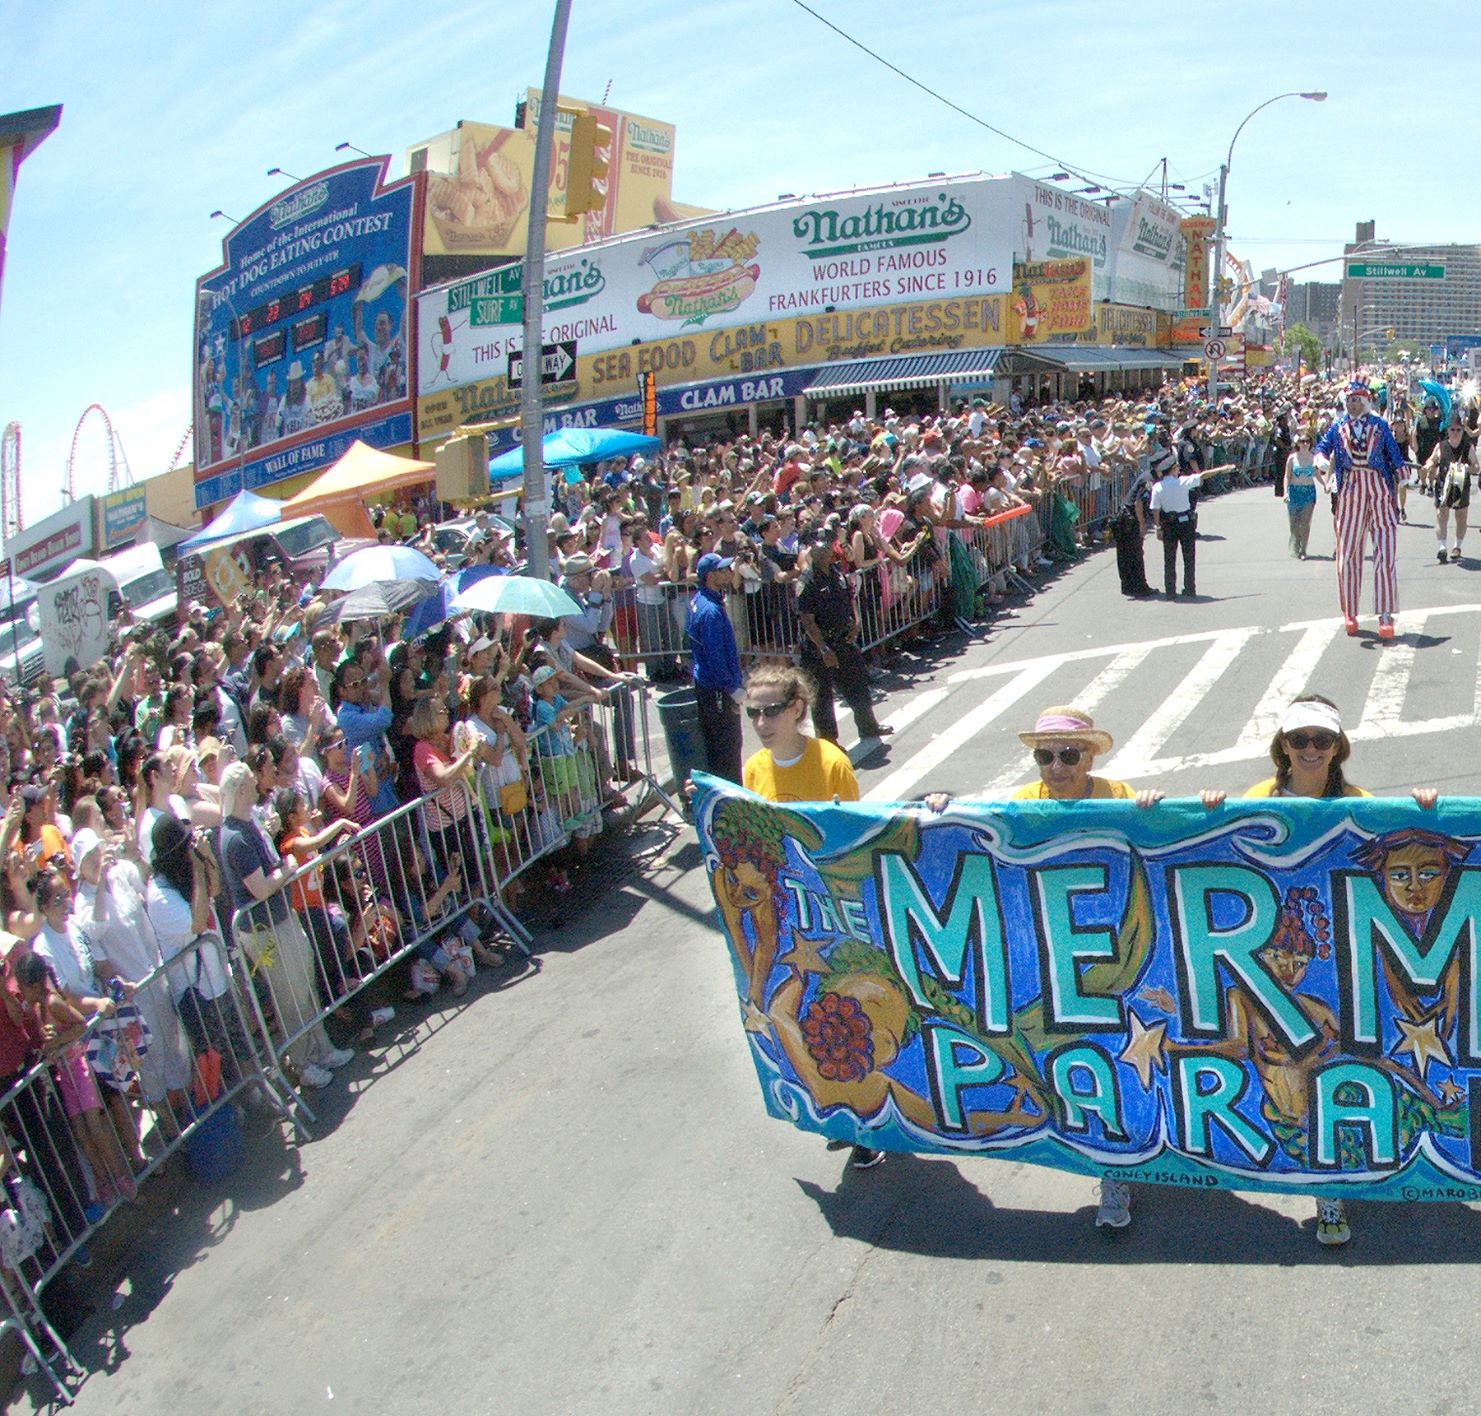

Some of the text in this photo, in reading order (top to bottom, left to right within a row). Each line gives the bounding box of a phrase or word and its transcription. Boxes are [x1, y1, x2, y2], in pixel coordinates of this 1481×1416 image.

[792, 193, 971, 245] Nathan's
[1034, 185, 1111, 228] THIS IS THE ORIGINAL
[277, 229, 293, 247] the
[293, 202, 358, 239] International
[211, 212, 393, 310] HOT DOG EATING CONTEST
[813, 248, 948, 282] WORLD FAMOUS
[1365, 266, 1427, 277] Stillwell Av
[452, 267, 521, 311] STILLWELL AV
[768, 268, 997, 312] FRANKFURTERS SINCE 1916
[476, 299, 505, 324] SURF
[550, 314, 618, 343] ORIGINAL
[795, 299, 1000, 354] DELICATESSEN
[472, 337, 517, 364] THIS IS
[709, 324, 767, 363] CLAM
[740, 342, 785, 373] BAR
[545, 355, 567, 373] WAY
[592, 341, 697, 384] SEA FOOD
[680, 377, 785, 410] CLAM BAR
[561, 408, 599, 429] BAR
[264, 457, 287, 476] WALL
[287, 452, 299, 467] OF
[301, 443, 326, 463] FAME
[783, 876, 872, 942] THE
[1104, 1170, 1219, 1186] CONEY ISLAND
